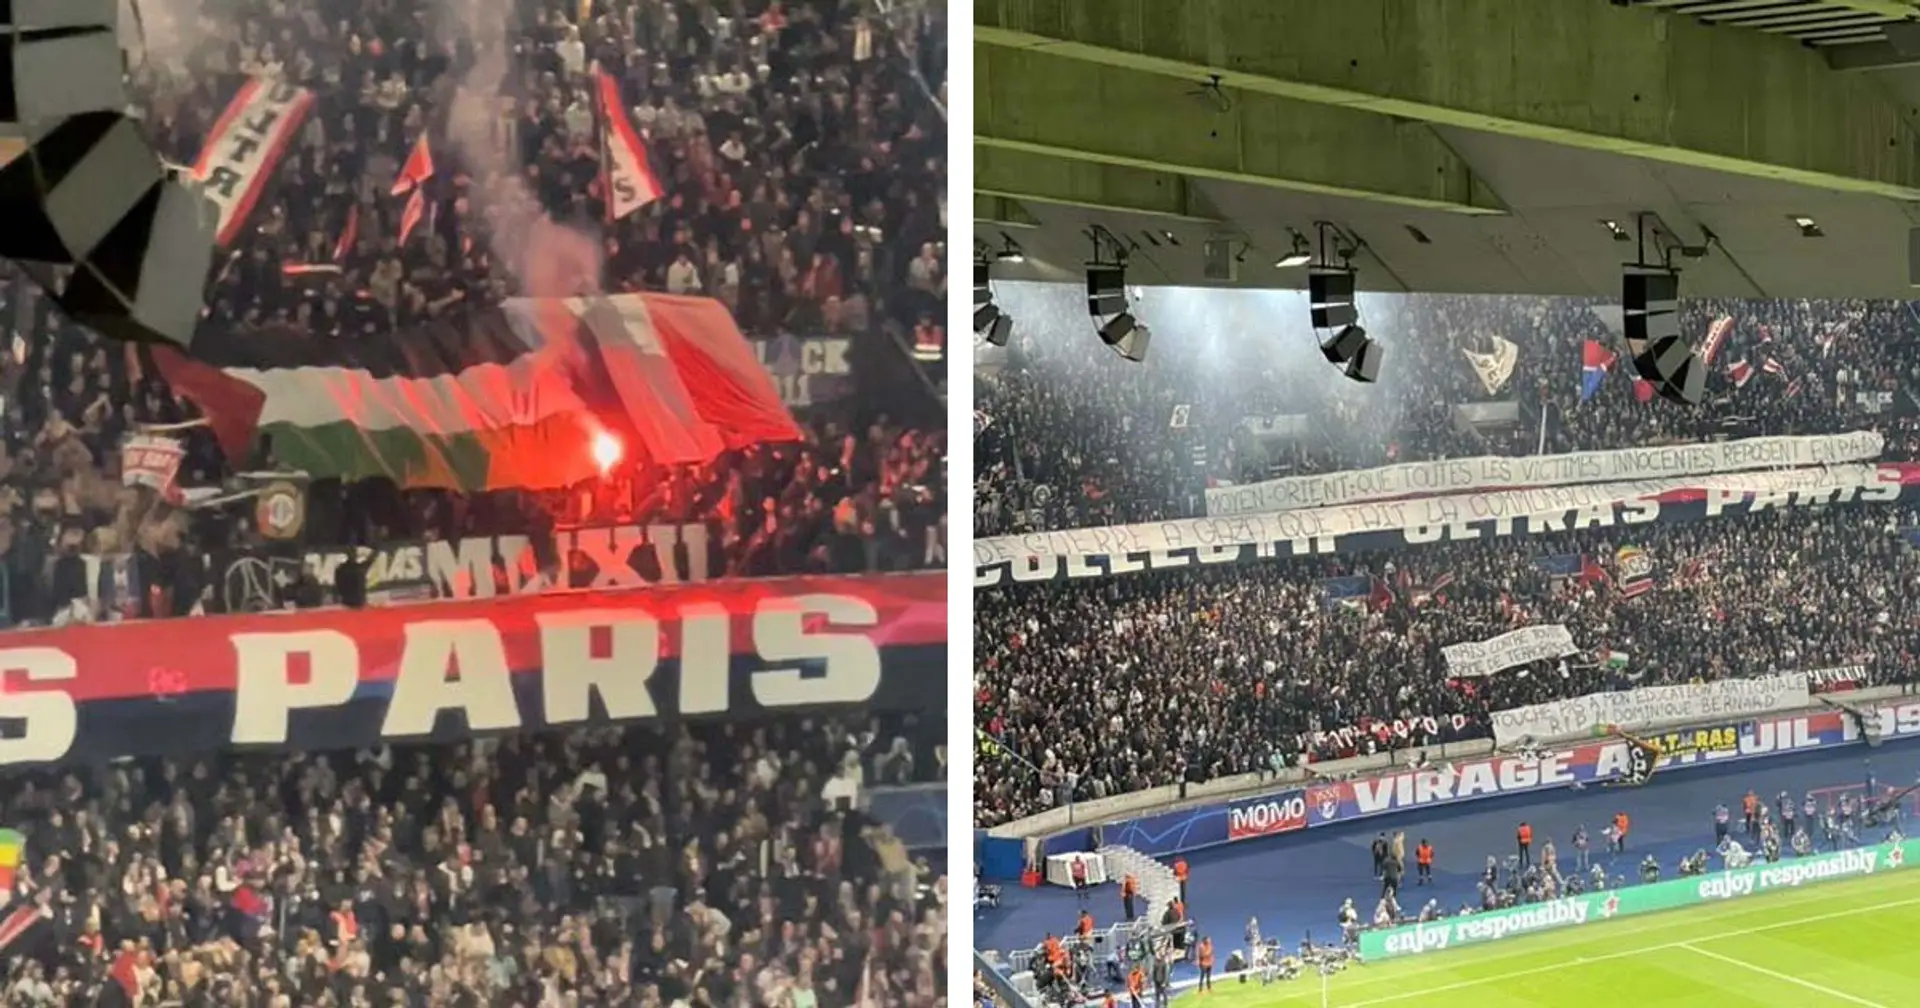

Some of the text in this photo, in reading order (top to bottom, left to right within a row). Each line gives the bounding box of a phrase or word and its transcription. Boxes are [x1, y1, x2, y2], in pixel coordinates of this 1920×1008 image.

[1404, 463, 1472, 488] TOUTES
[1482, 459, 1512, 481] LES
[1521, 454, 1601, 480] VICTIMES
[1613, 449, 1716, 474] INNOCENTES
[1723, 439, 1800, 464] REPOSENT
[1811, 440, 1835, 461] EN
[1023, 522, 1147, 555] GUERRE
[1162, 522, 1183, 547] A
[1192, 515, 1265, 545] GAZA
[1278, 509, 1334, 539] QUE
[1343, 503, 1407, 529] FAIT
[1426, 497, 1458, 524] LA
[230, 594, 881, 744] PARIS
[1719, 673, 1806, 696] NATIONALE
[1613, 700, 1691, 722] DOMINIQUE
[1352, 750, 1576, 813] VIRAGE
[1596, 717, 1821, 777] AUIL
[1232, 796, 1305, 830] MOMO
[1698, 847, 1878, 898] enjoy responsibly
[1384, 897, 1590, 953] enjoy responsibly
